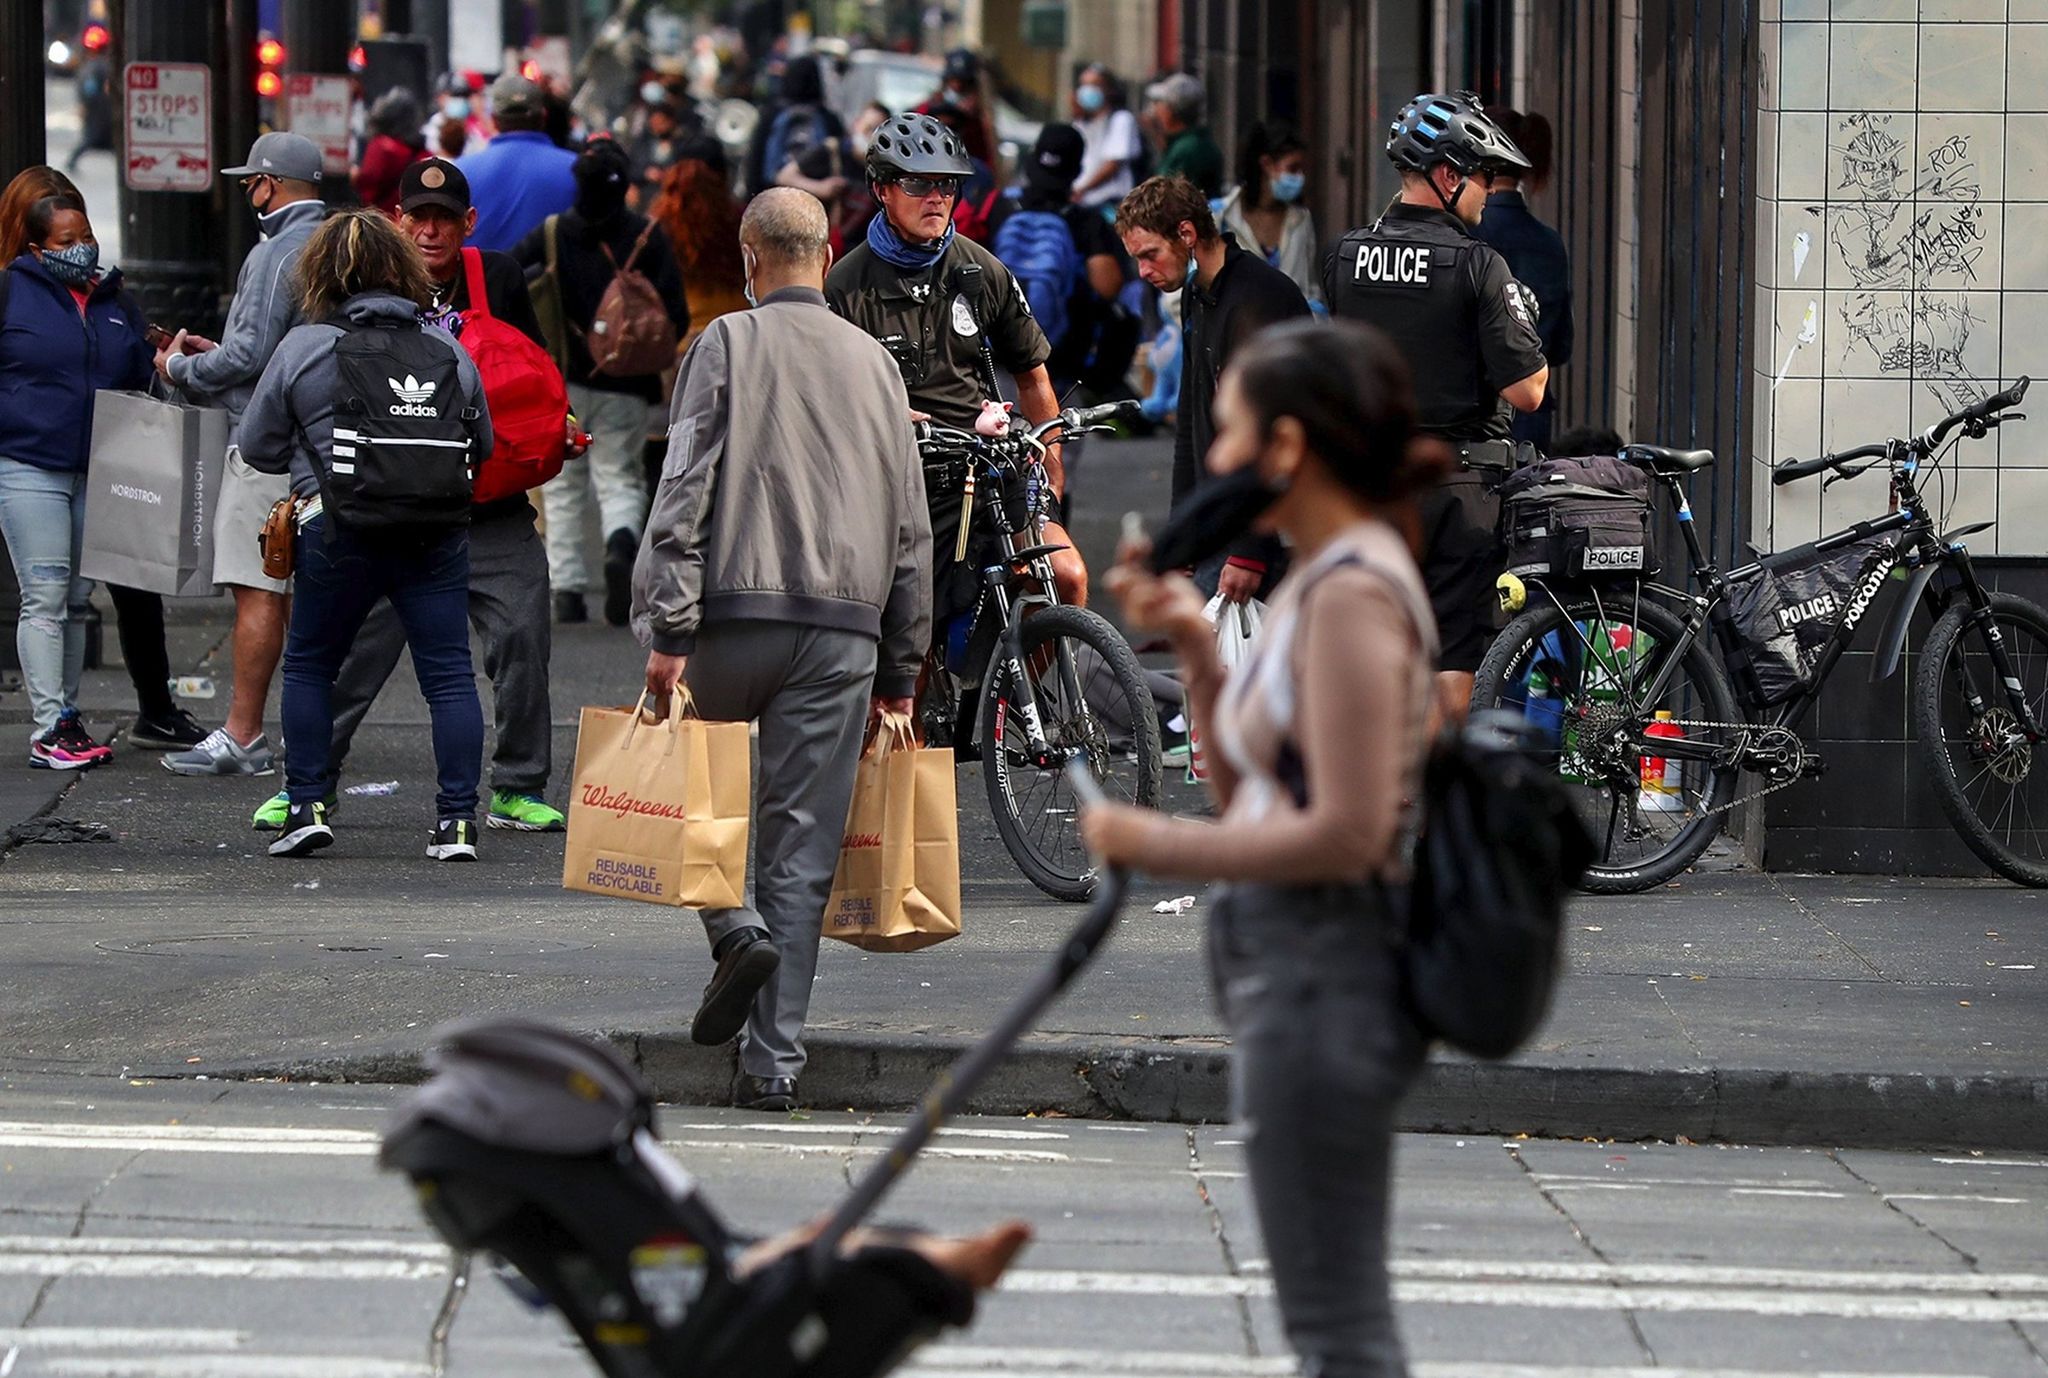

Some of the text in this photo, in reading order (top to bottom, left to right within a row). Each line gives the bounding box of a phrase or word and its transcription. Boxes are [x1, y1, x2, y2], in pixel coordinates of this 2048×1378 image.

[131, 69, 153, 85] NO
[137, 95, 198, 116] STOPS
[1353, 244, 1430, 283] POLICE
[389, 404, 437, 418] adidas
[111, 483, 161, 505] NORDSTROM
[192, 461, 204, 547] NORDSTROM
[1587, 550, 1639, 566] POLICE
[1780, 595, 1836, 627] POLICE
[582, 783, 686, 819] Walgreens
[596, 859, 656, 880] REUSABLE
[587, 872, 662, 896] RECYCLABLE
